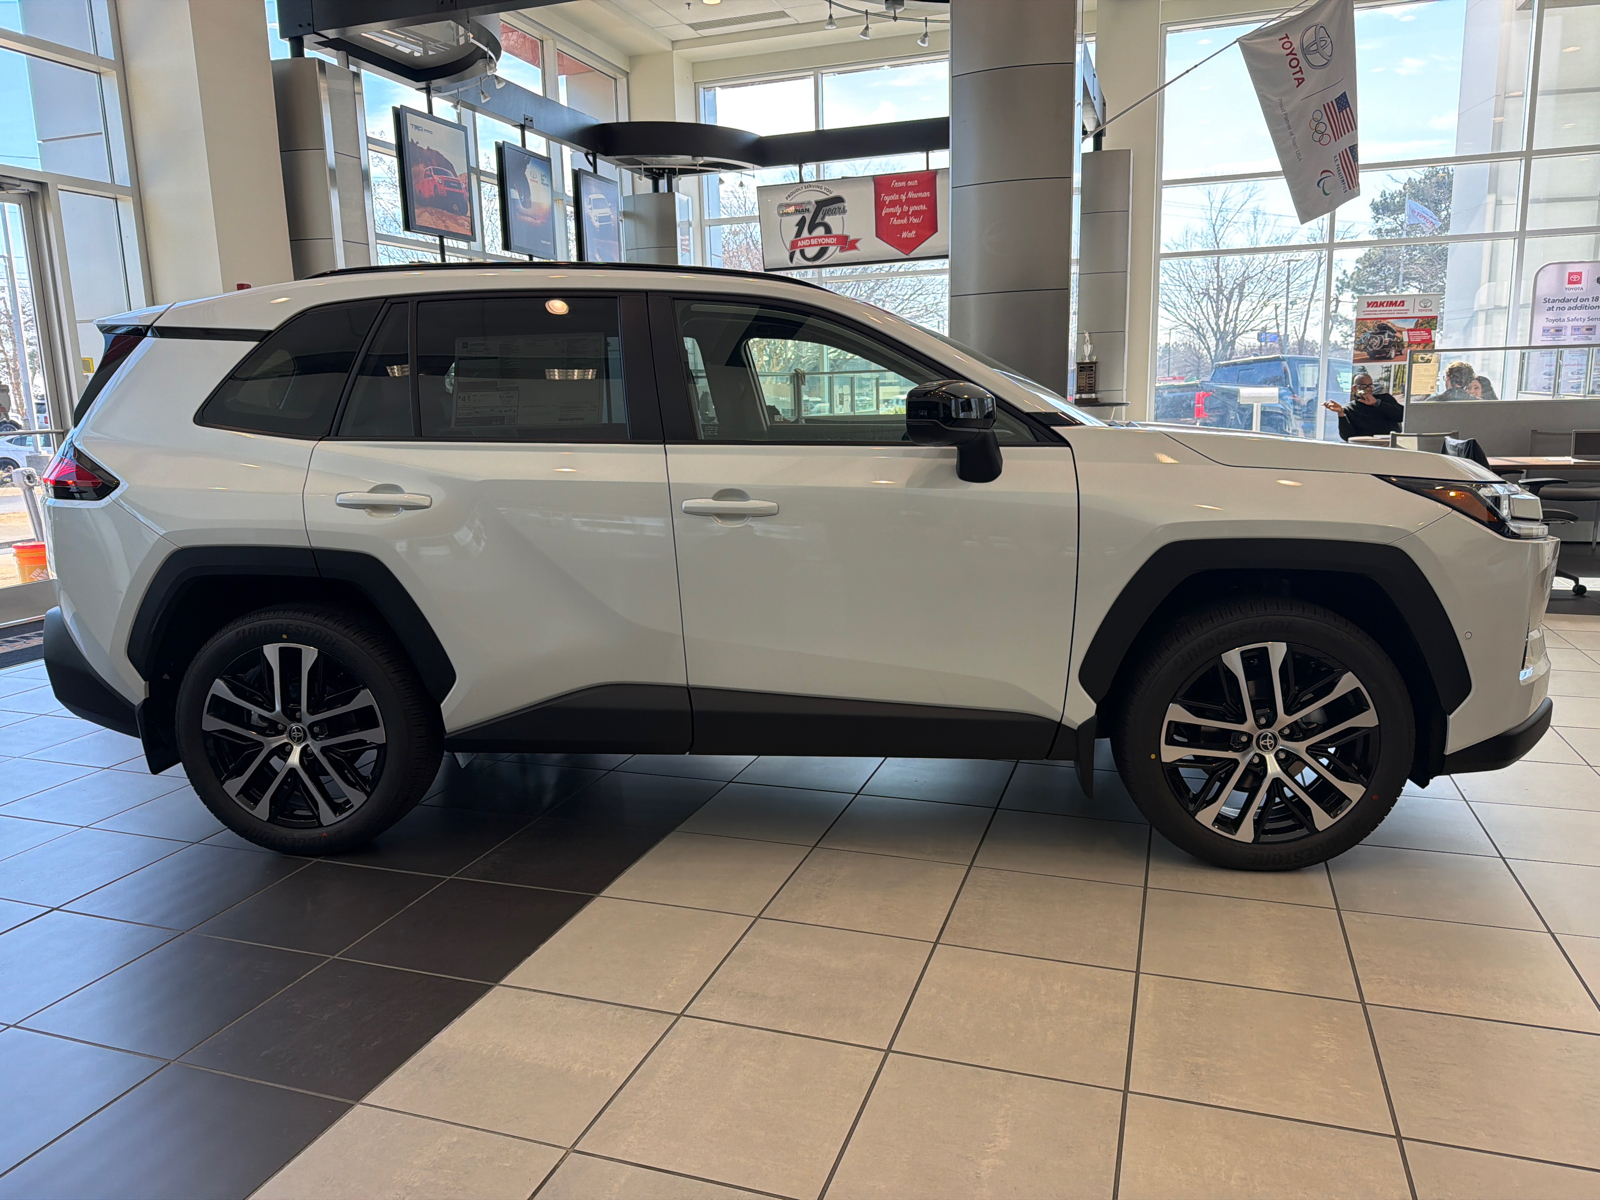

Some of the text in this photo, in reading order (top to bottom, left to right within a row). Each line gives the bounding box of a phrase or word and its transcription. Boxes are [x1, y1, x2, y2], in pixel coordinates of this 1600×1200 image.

[1278, 33, 1305, 88] TOYOTA
[1283, 112, 1292, 130] Partner
[785, 187, 803, 200] PROUDLY
[880, 194, 899, 204] Toyota
[900, 192, 907, 202] of
[821, 205, 847, 221] years
[882, 205, 901, 216] family
[909, 204, 927, 214] yours.
[889, 215, 923, 225] Thank You!
[789, 195, 845, 264] 15
[901, 230, 916, 238] Walt
